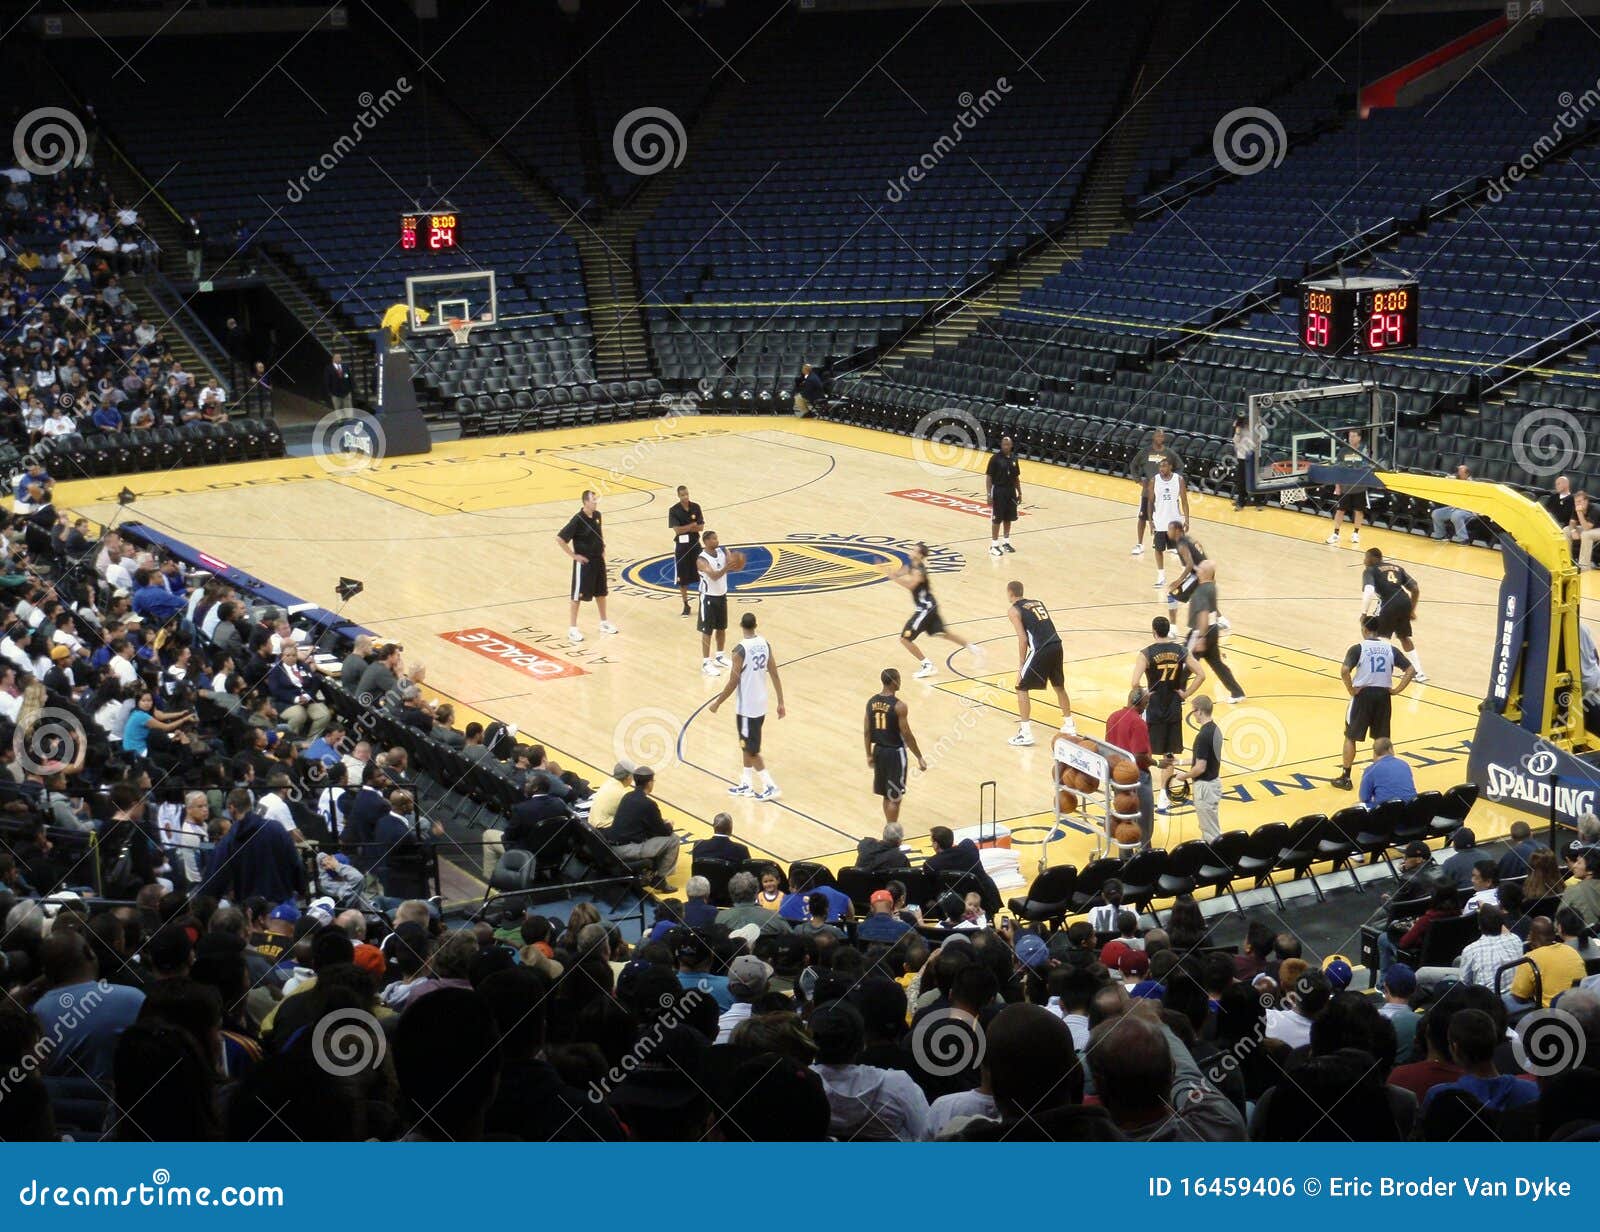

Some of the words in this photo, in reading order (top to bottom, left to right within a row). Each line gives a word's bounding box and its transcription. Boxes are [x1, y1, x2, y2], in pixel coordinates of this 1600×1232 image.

[432, 215, 456, 229] 8:00
[430, 228, 453, 248] 24
[1309, 292, 1332, 314] 8:00
[1374, 290, 1407, 313] 8:00
[1307, 313, 1328, 347] 24
[1370, 314, 1401, 347] 24
[1387, 570, 1398, 583] 4
[1031, 606, 1049, 621] 15
[455, 631, 566, 676] ORACLE
[752, 653, 766, 671] 32
[1494, 620, 1514, 699] NBA.COM
[1157, 663, 1179, 682] 77
[1370, 655, 1386, 673] 12
[875, 712, 887, 729] 11
[1486, 762, 1595, 818] SPALDING
